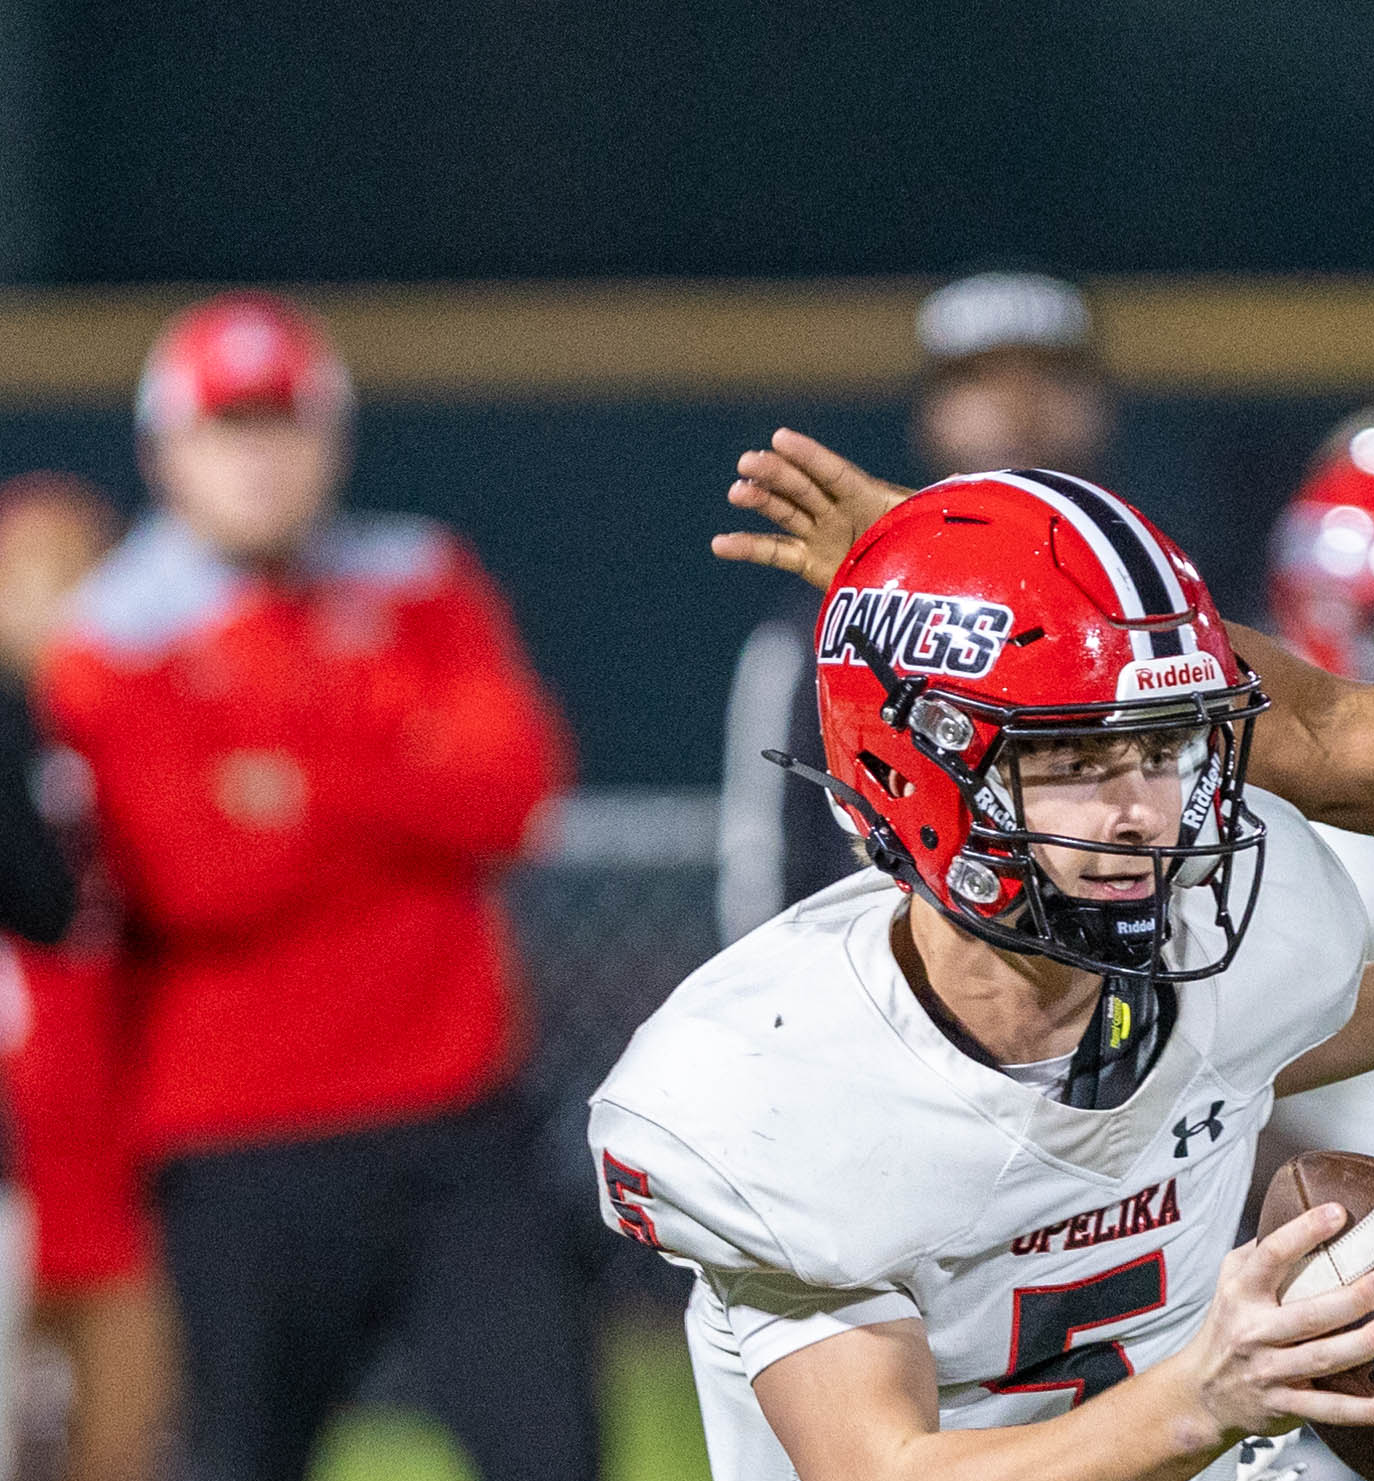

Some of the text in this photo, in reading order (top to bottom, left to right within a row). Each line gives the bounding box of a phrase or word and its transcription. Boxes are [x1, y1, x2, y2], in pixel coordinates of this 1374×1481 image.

[818, 582, 1014, 679] DAWGS
[1135, 658, 1215, 691] Riddell
[979, 1248, 1167, 1411] 5
